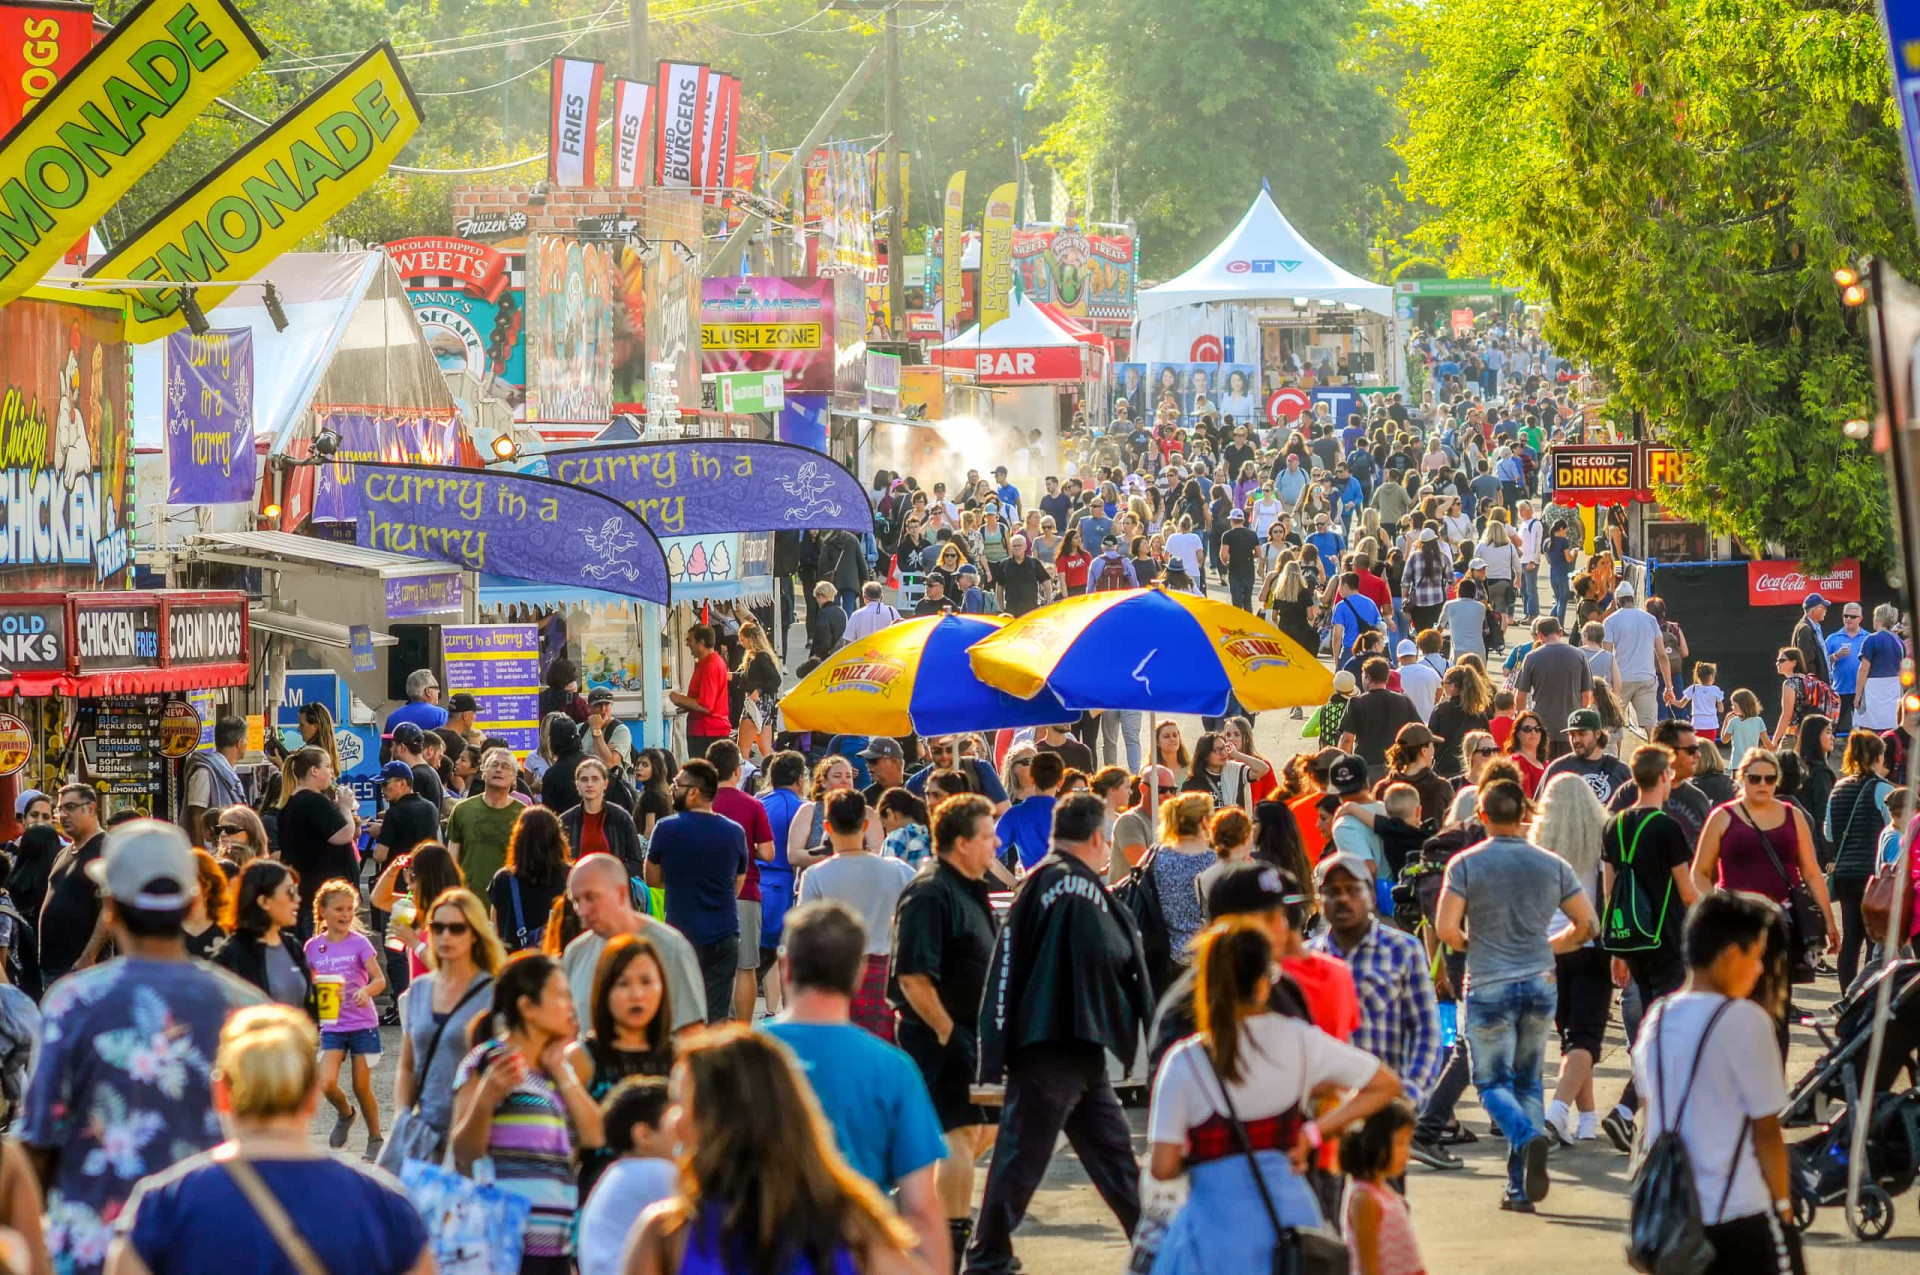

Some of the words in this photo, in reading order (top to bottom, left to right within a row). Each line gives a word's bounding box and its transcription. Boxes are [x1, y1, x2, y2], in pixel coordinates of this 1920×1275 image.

[562, 94, 583, 157] FRIES
[673, 79, 697, 181] BURGERS
[0, 3, 229, 281] MONADE
[620, 114, 639, 174] FRIES
[664, 127, 675, 178] STUFFED
[126, 79, 399, 322] EMONADE
[456, 218, 507, 237] Frozen
[445, 242, 484, 256] DIPPED
[1014, 240, 1048, 254] SWEETS
[1094, 242, 1127, 260] TREATS
[998, 227, 1012, 312] CHEESE
[1226, 259, 1302, 273] CTV
[984, 263, 997, 310] MAC
[702, 328, 760, 345] SLUSH
[765, 328, 815, 344] ZONE
[975, 352, 1036, 375] BAR
[201, 386, 212, 420] in
[216, 388, 222, 416] a
[190, 419, 231, 477] hurry
[1572, 456, 1588, 466] ICE
[1589, 456, 1615, 466] COLD
[559, 451, 678, 488] curry
[690, 450, 722, 481] in
[734, 455, 753, 477] a
[1559, 468, 1629, 487] DRINKS
[365, 472, 487, 520] curry
[498, 484, 526, 521] in
[540, 498, 558, 522] a
[97, 528, 127, 582] FRIES
[368, 511, 487, 569] hurry
[1820, 580, 1844, 590] CENTRE
[78, 612, 135, 658] CHICKEN
[143, 611, 149, 627] &
[135, 631, 157, 658] FRIES
[169, 613, 203, 660] CORN
[208, 612, 241, 657] DOGS
[444, 634, 474, 649] curry
[476, 635, 483, 647] in
[486, 636, 491, 646] a
[493, 630, 523, 649] hurry
[830, 664, 870, 683] PRIZE
[145, 697, 159, 705] $12
[163, 708, 185, 717] NEW
[98, 715, 120, 724] BIG
[149, 719, 159, 727] $9
[148, 762, 160, 770] $4
[354, 782, 373, 798] ES
[1040, 874, 1109, 913] SECURITY
[995, 926, 1011, 1031] SECURITY
